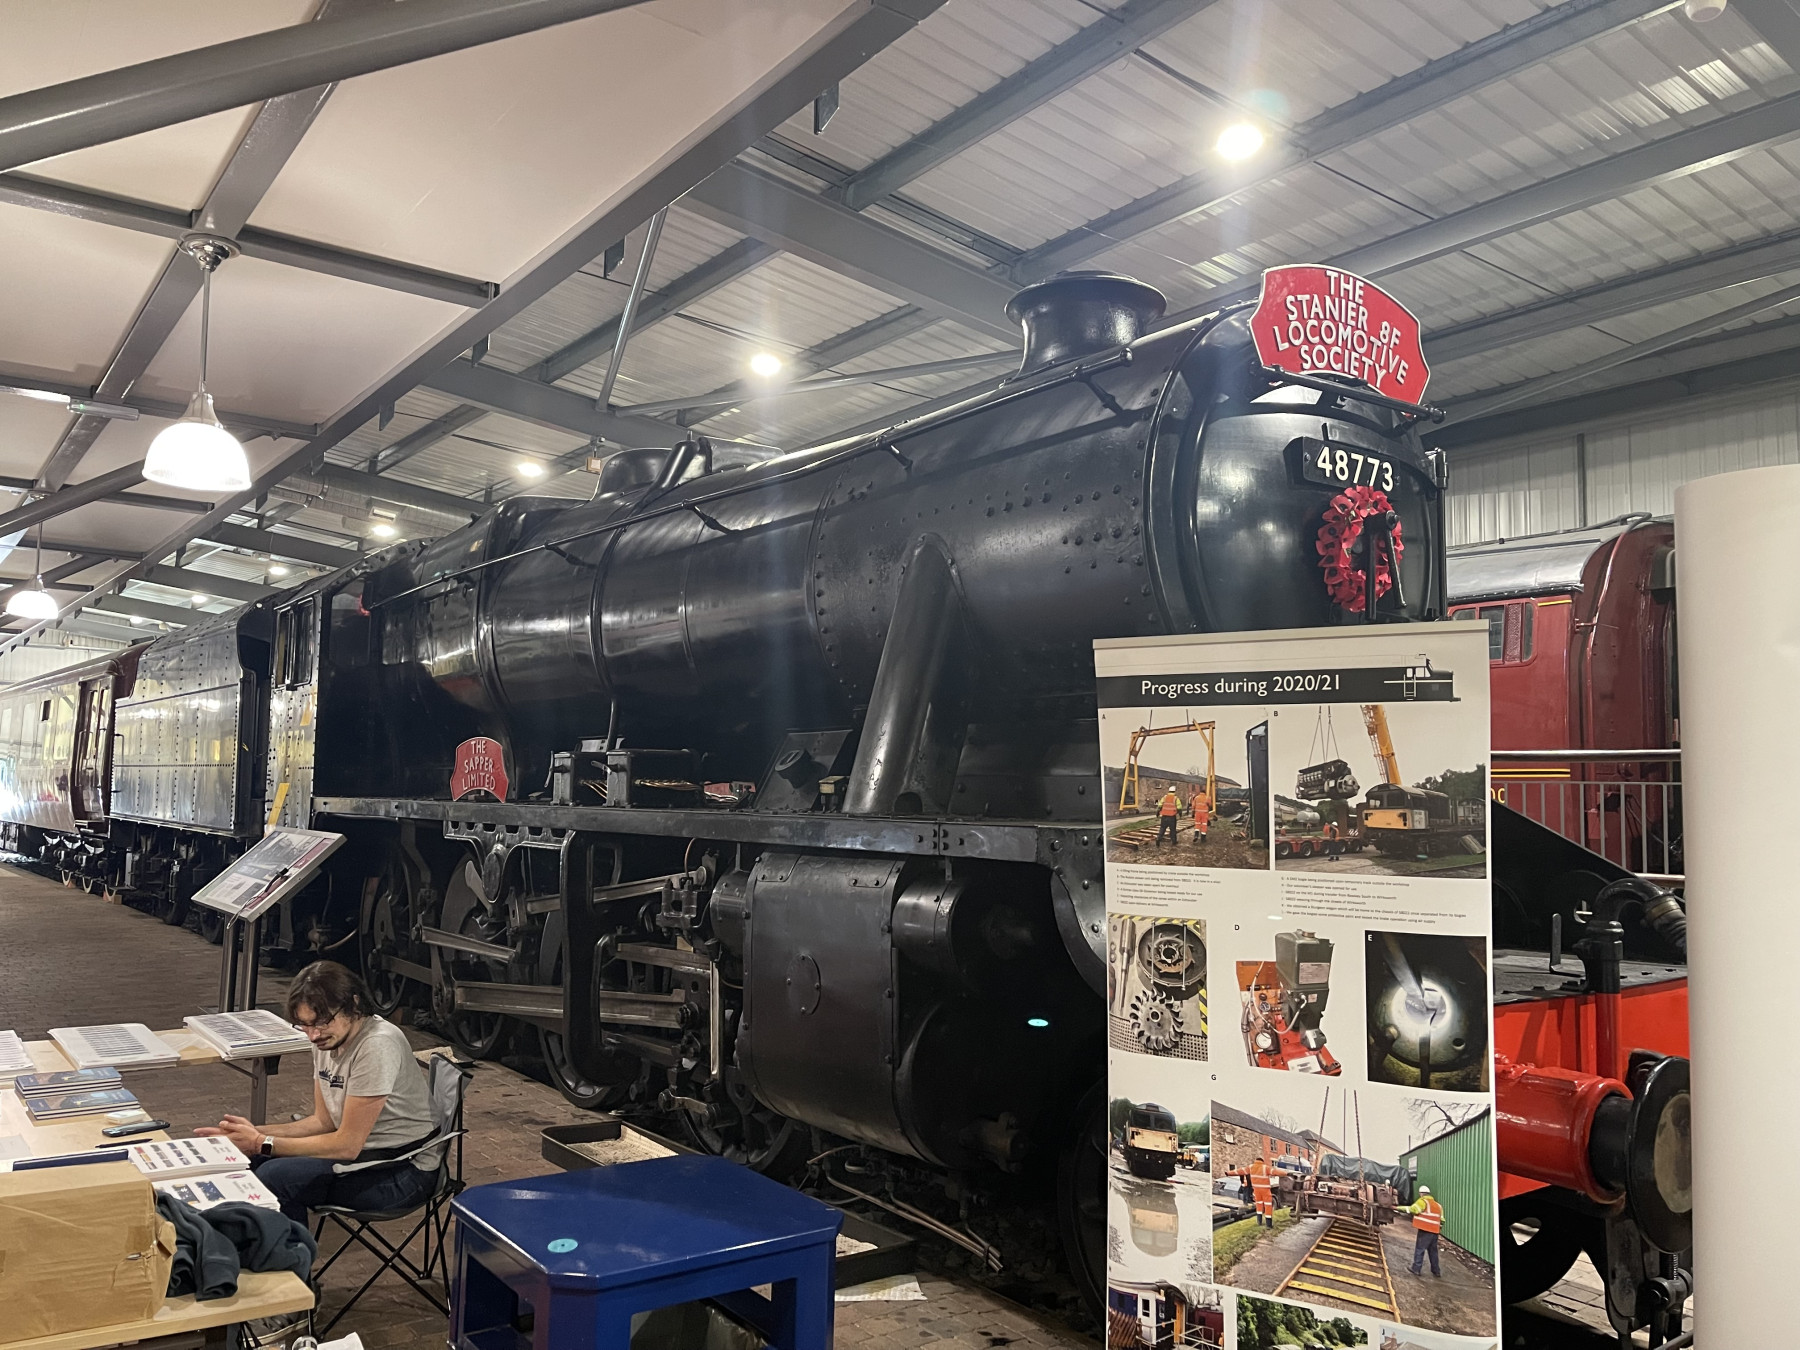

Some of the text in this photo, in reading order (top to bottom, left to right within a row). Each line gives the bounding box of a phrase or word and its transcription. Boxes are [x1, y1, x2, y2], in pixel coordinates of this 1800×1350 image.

[1325, 270, 1365, 305] THE
[1285, 294, 1401, 349] STANIER 8F
[1273, 320, 1409, 385] LOCOMOTIVE
[1300, 345, 1387, 389] SOCIETY
[1317, 446, 1394, 492] 48773
[1141, 674, 1340, 699] Progress during 2020/21
[470, 740, 486, 754] THE
[464, 756, 494, 774] SAPPER
[462, 772, 496, 791] LIMITED
[1367, 934, 1373, 942] E
